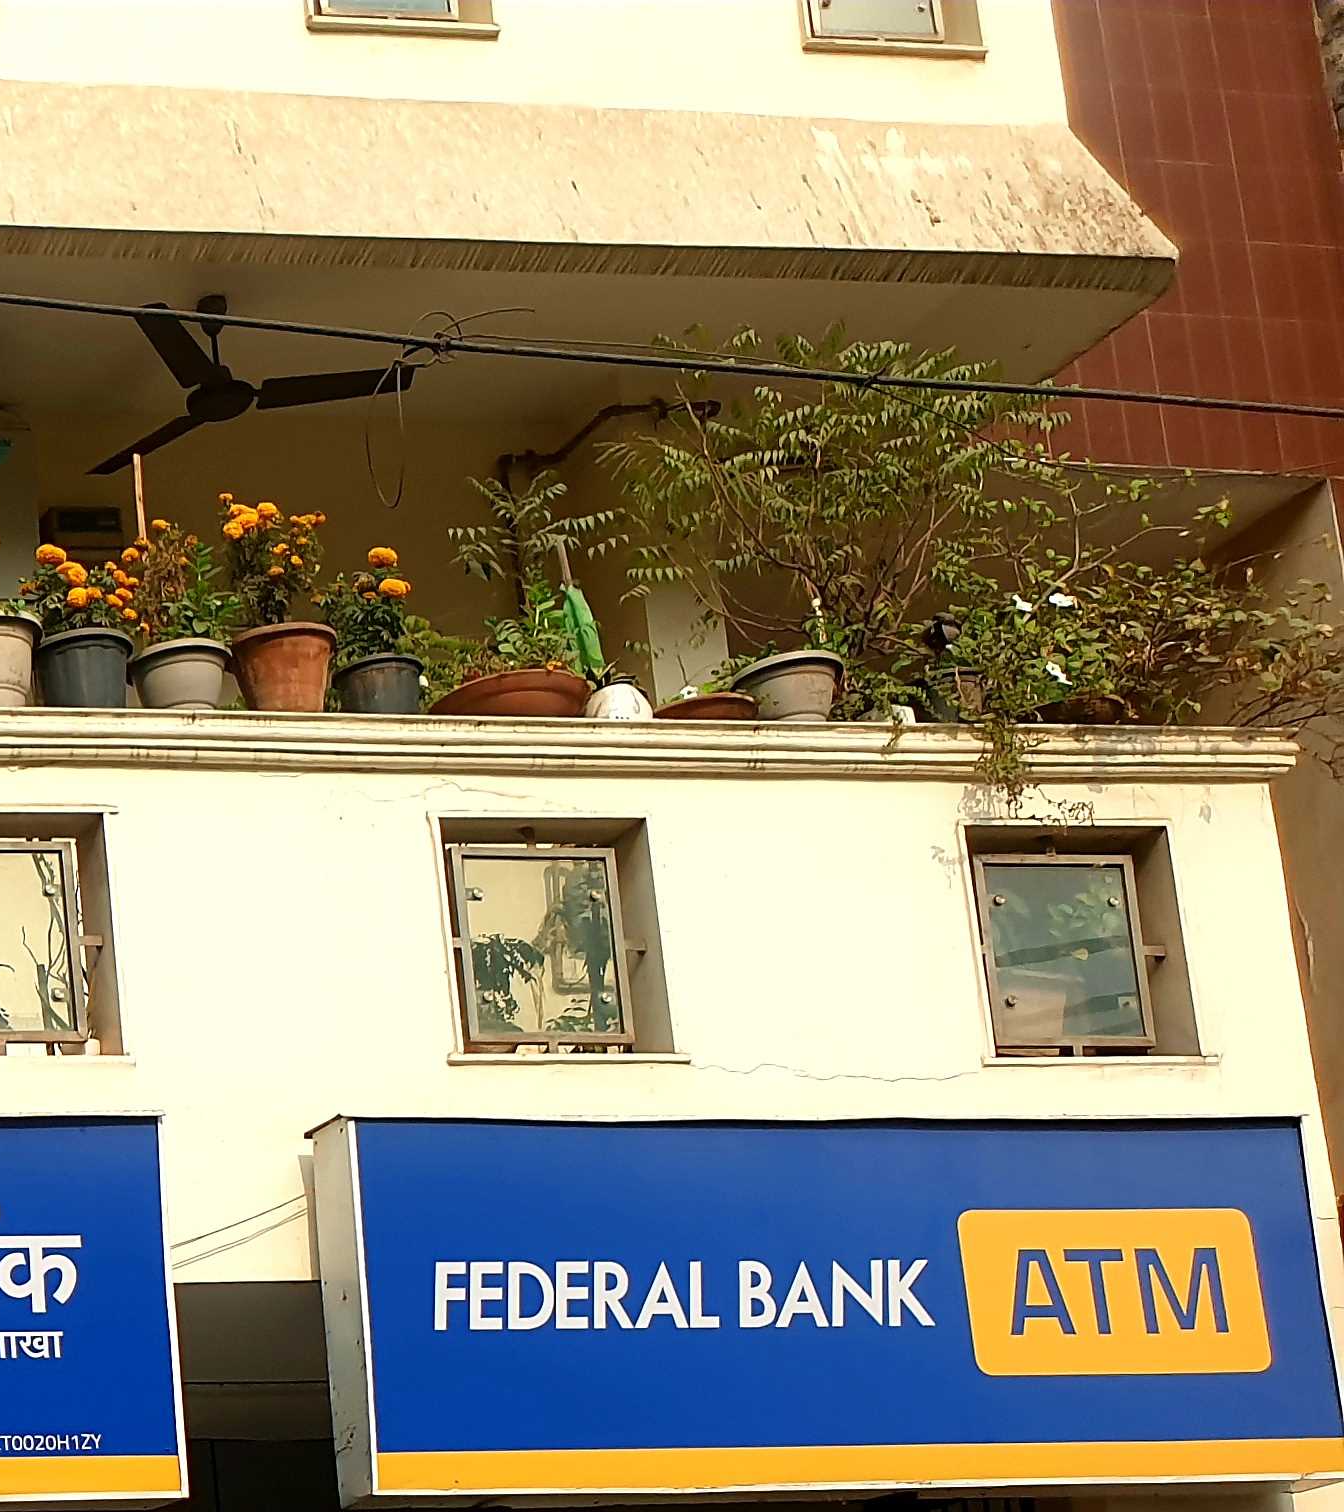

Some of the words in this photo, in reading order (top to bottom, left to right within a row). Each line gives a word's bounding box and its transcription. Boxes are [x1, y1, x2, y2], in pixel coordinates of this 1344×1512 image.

[433, 1260, 718, 1331] FEDERAL
[738, 1258, 935, 1329] BANK
[1010, 1248, 1230, 1336] ATM
